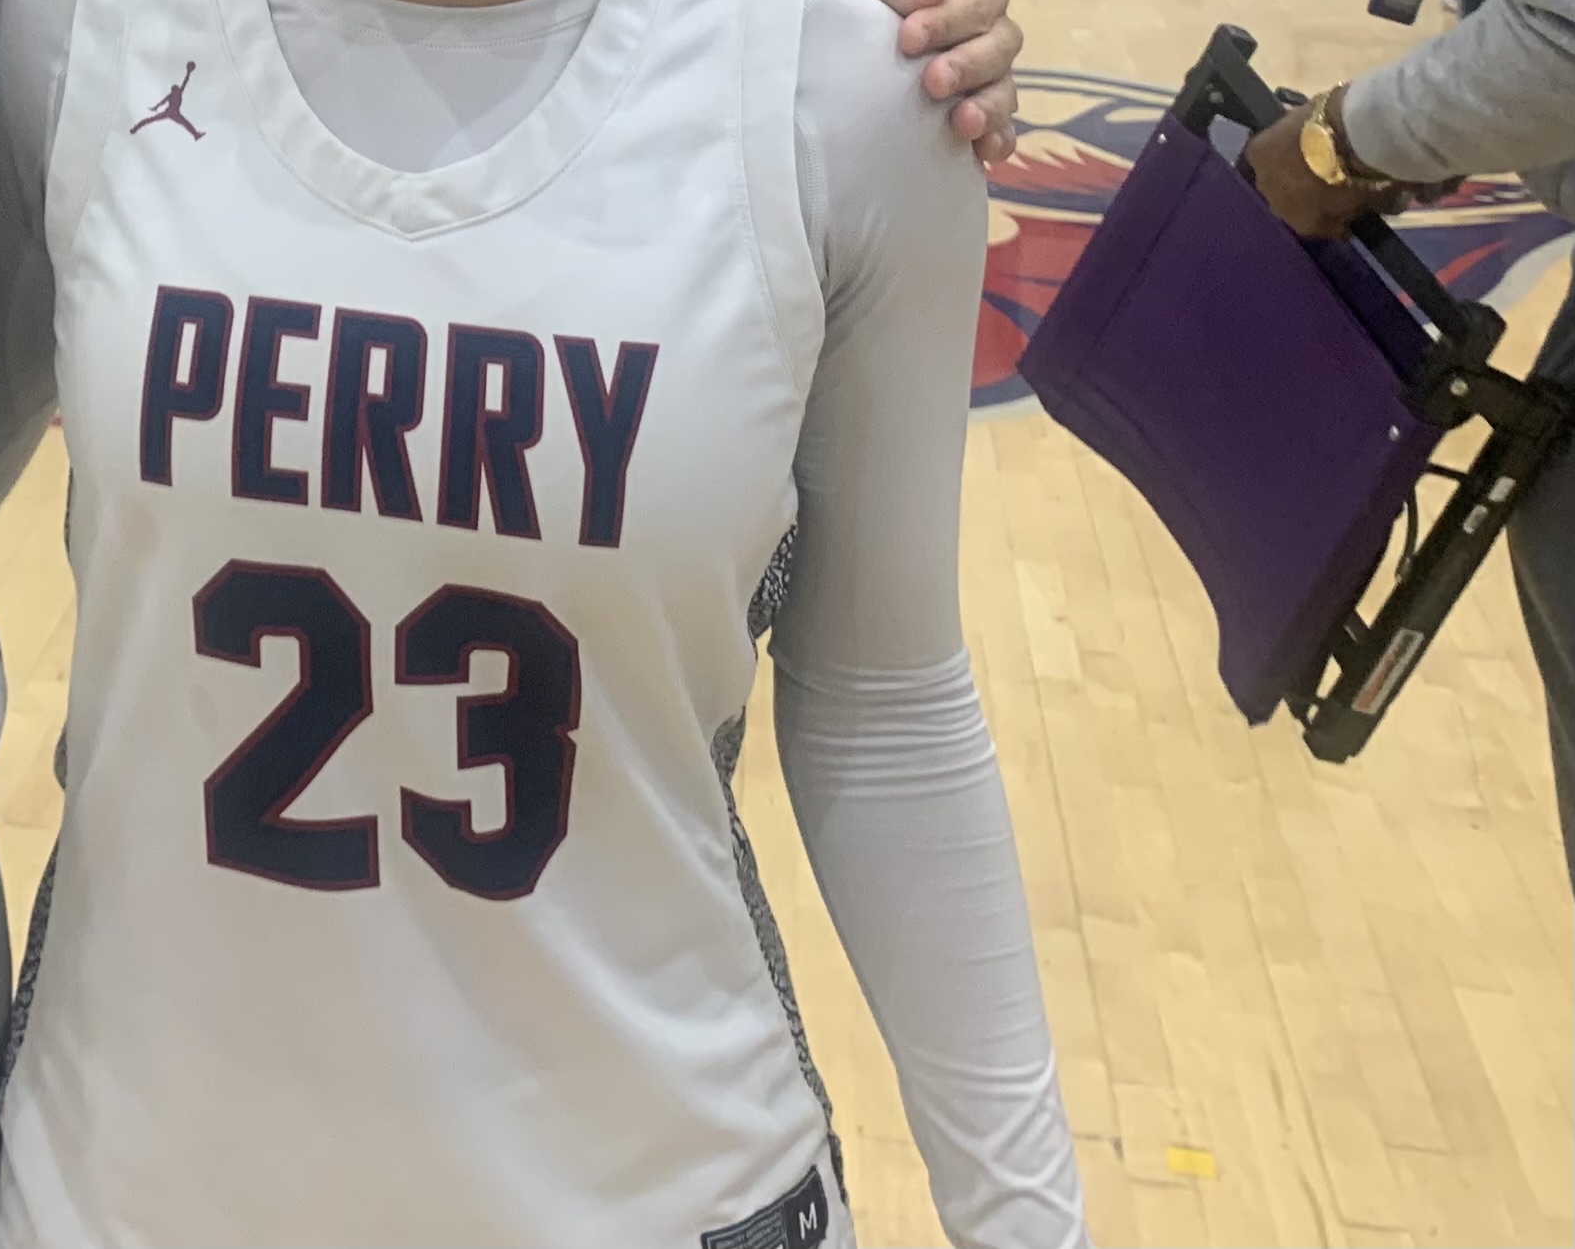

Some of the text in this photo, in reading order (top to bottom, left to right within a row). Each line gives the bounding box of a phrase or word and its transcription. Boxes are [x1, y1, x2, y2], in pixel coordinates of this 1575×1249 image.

[139, 284, 661, 549] PERRY
[192, 558, 583, 902] 23
[798, 1201, 818, 1241] M
